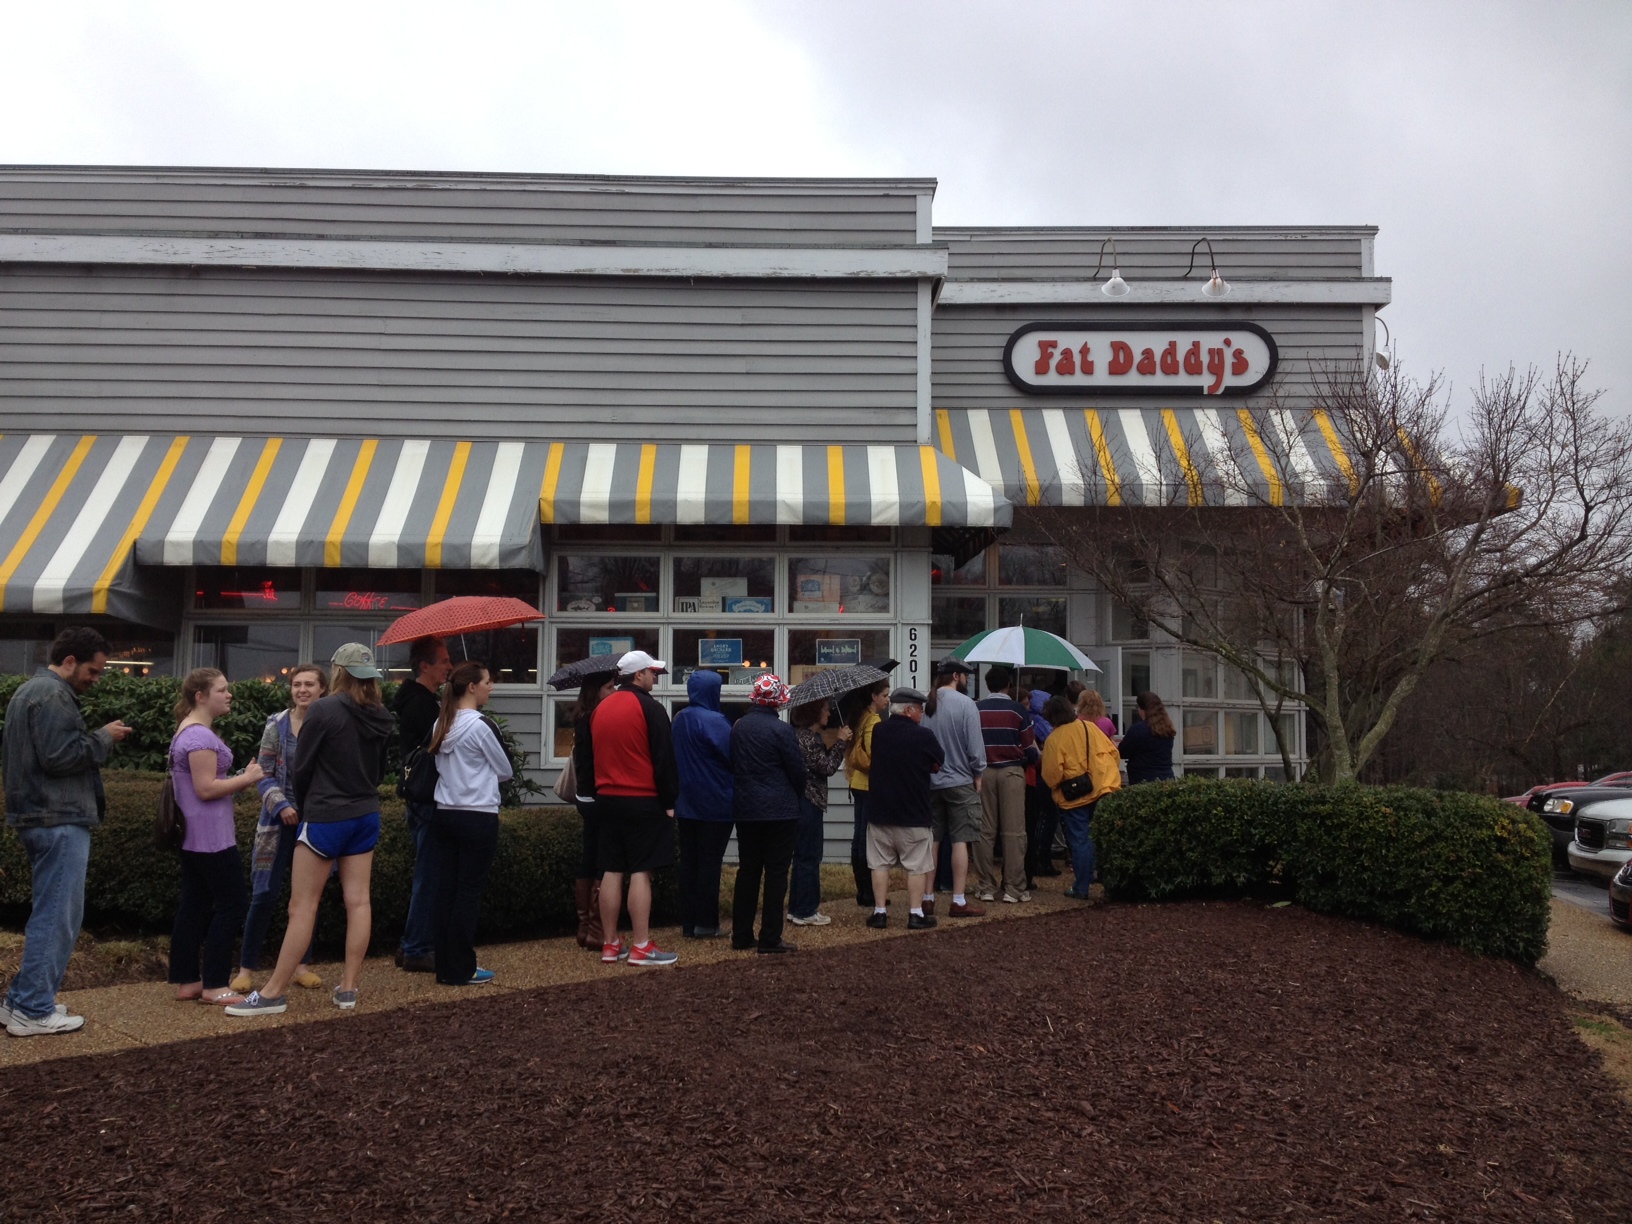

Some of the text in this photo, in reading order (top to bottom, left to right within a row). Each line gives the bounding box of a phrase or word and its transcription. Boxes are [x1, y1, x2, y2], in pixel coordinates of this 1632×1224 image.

[1034, 337, 1250, 395] Fat Daddy's
[680, 601, 697, 613] IPA
[909, 627, 918, 689] 6201
